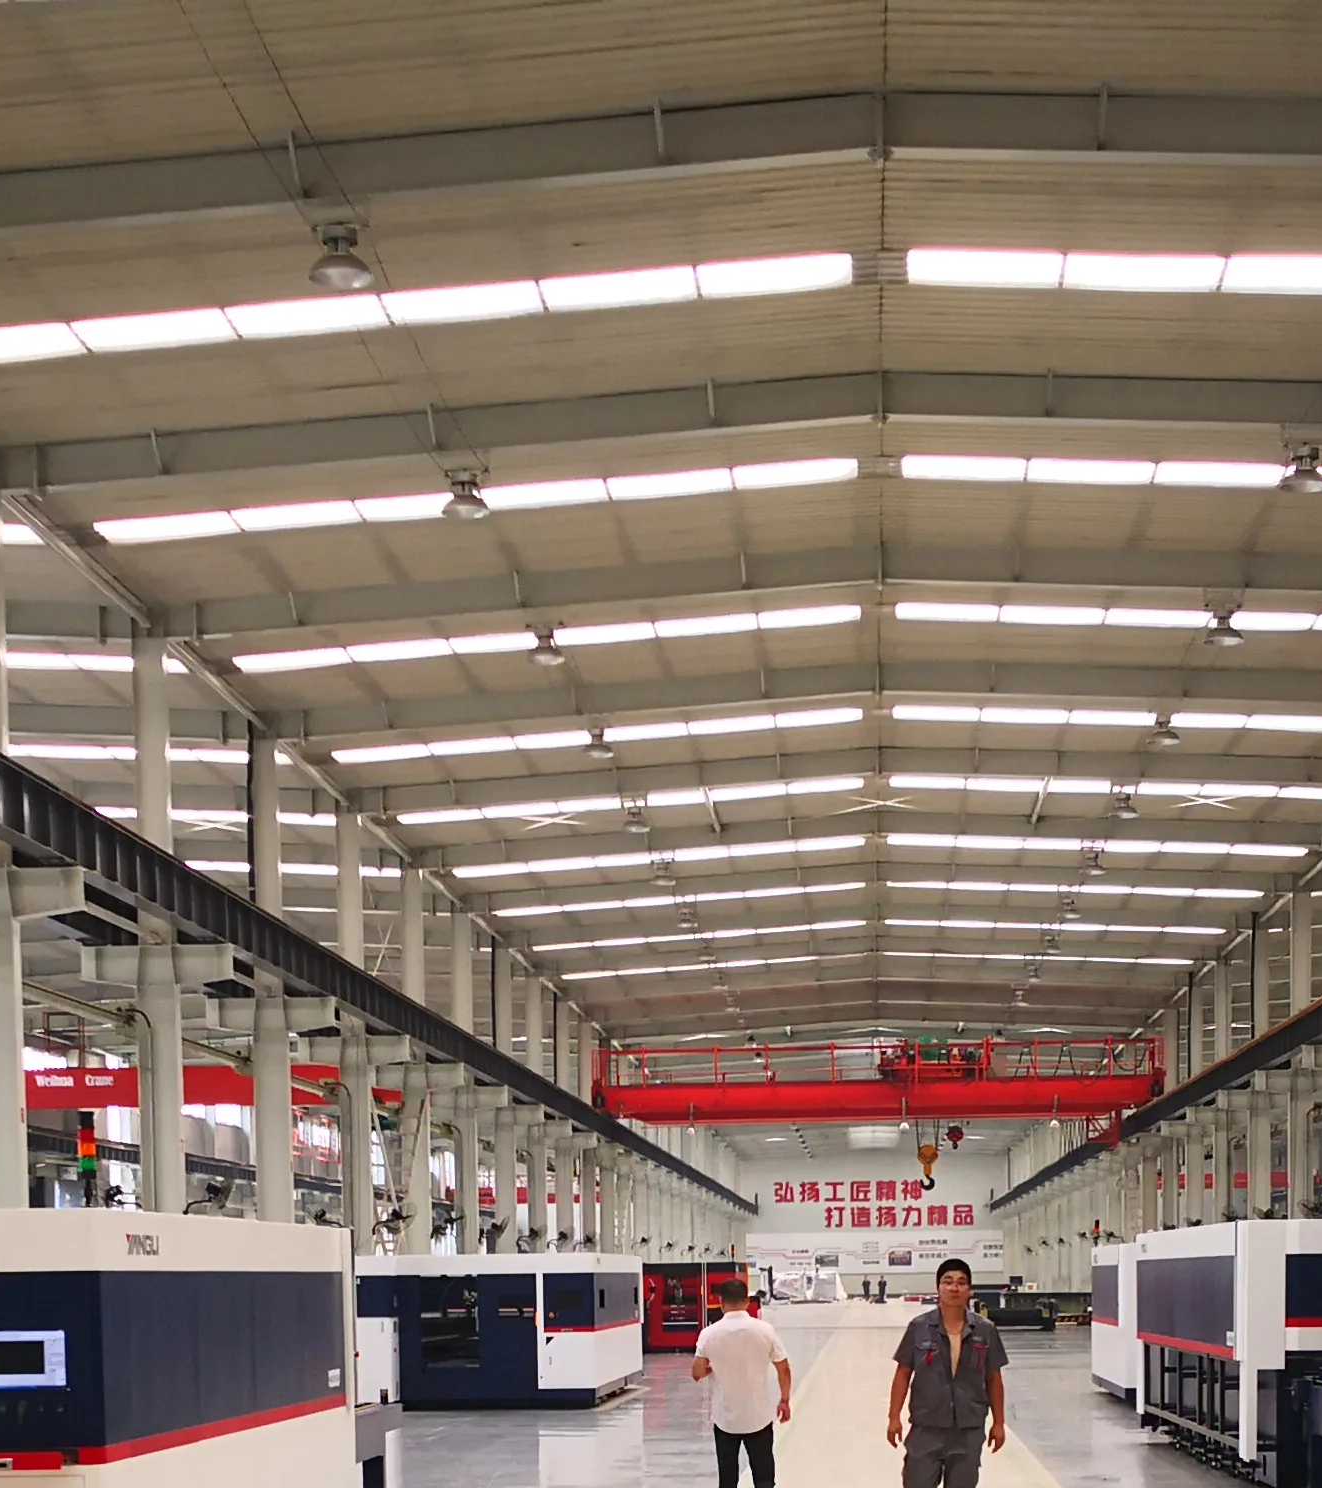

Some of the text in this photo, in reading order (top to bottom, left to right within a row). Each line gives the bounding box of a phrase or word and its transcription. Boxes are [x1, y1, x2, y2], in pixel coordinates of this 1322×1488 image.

[773, 1180, 923, 1204] 弘扬工匠精神
[824, 1204, 974, 1228] 打造扬力精品
